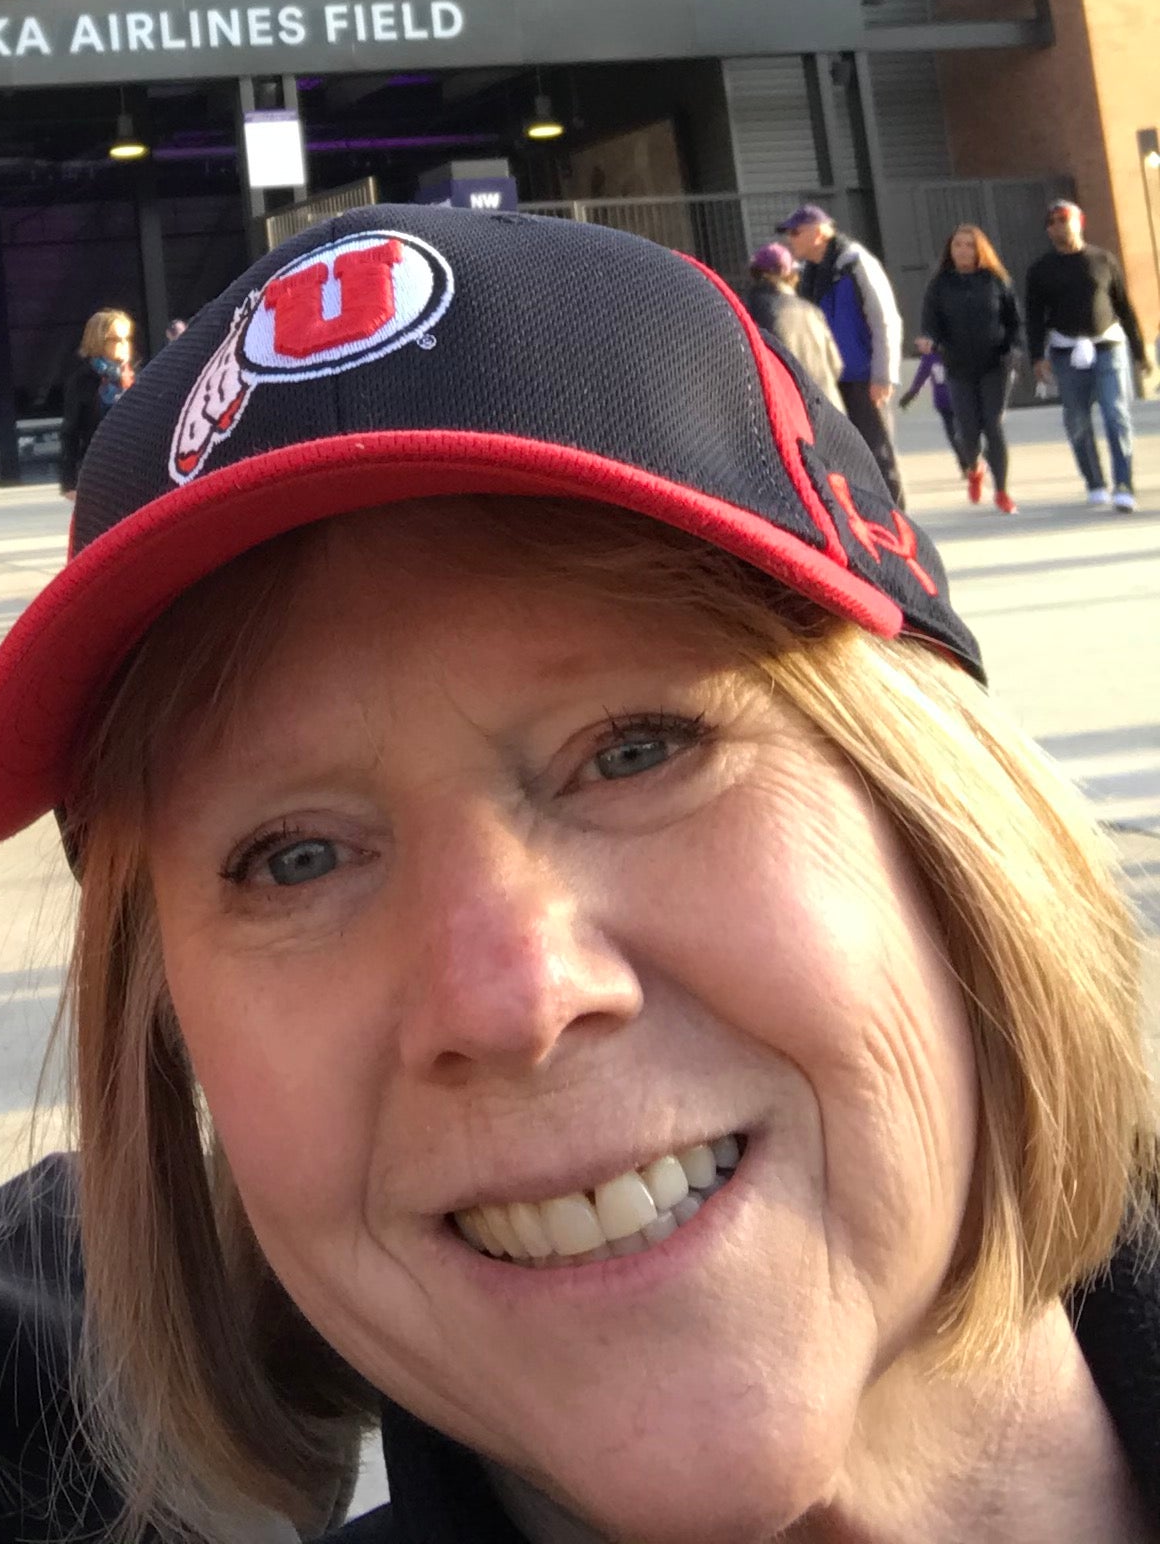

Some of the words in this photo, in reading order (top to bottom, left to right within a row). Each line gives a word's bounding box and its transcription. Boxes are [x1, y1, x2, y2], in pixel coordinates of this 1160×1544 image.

[70, 6, 307, 54] AIRLINES
[324, 1, 465, 44] FIELD
[263, 239, 404, 358] U
